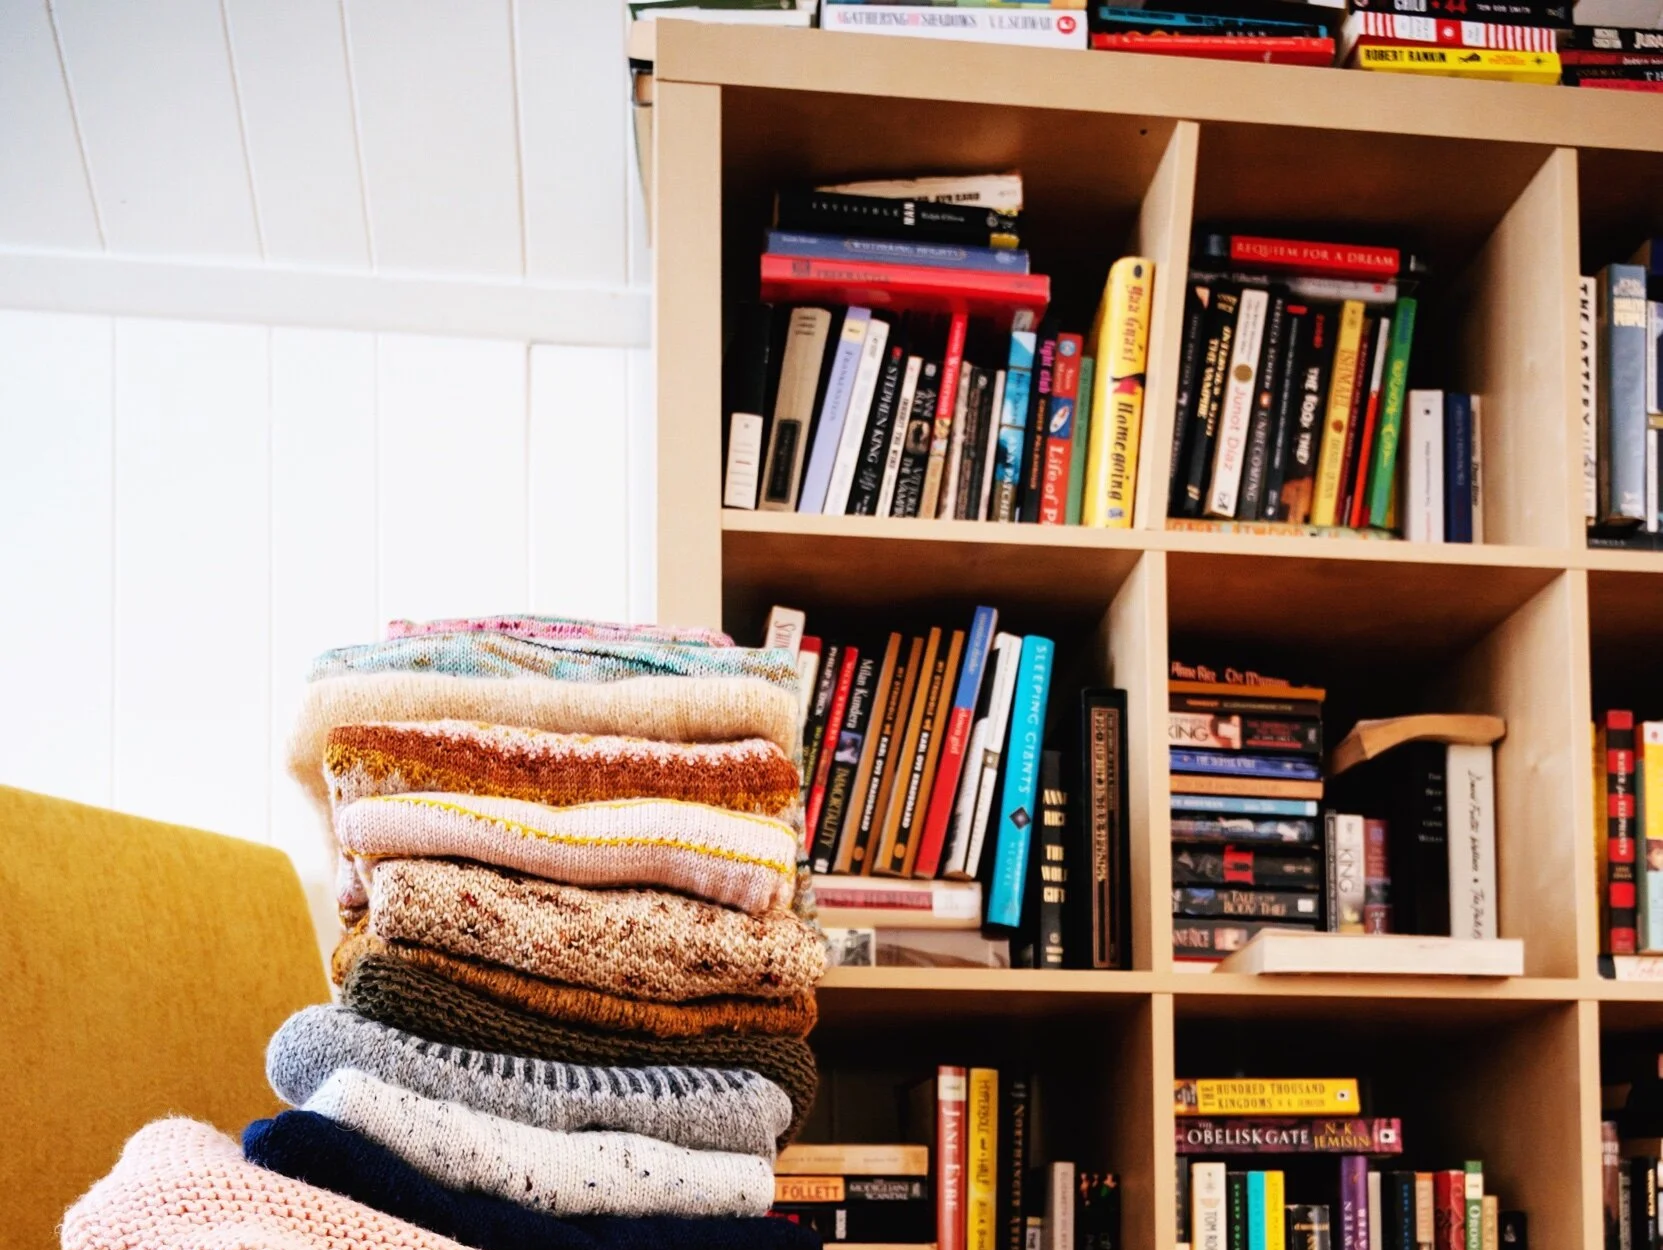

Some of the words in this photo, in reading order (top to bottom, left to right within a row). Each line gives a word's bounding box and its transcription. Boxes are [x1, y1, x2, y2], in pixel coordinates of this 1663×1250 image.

[1364, 49, 1403, 62] ROBERT
[1408, 51, 1447, 64] RANKIN
[1236, 241, 1298, 260] REQUIEM
[1303, 247, 1330, 262] FOR
[1334, 250, 1345, 262] A
[1347, 250, 1395, 267] DREAM
[1579, 284, 1590, 322] THE
[1041, 340, 1056, 367] fight
[938, 355, 960, 417] Winterson
[1038, 369, 1053, 394] club
[1196, 366, 1216, 418] VAMPIRE
[1303, 367, 1320, 390] THE
[1331, 349, 1355, 409] ISHMAEL
[876, 365, 898, 428] STEPHEN
[1229, 385, 1247, 433] Junot
[1299, 394, 1318, 429] BOOK
[866, 428, 885, 464] KING
[1108, 401, 1134, 502] Homegoing
[1245, 411, 1269, 502] UNBECOMING
[1294, 432, 1313, 466] THIEF
[1047, 444, 1065, 483] Life
[1045, 484, 1059, 509] of
[824, 648, 838, 679] PHILIP
[854, 660, 875, 686] Milan
[1026, 645, 1047, 724] SLEEPING
[815, 690, 829, 717] DICK
[846, 687, 870, 729] Kundera
[877, 736, 890, 757] KARL
[917, 731, 930, 754] KARL
[948, 736, 961, 756] girl
[1169, 724, 1210, 742] KING
[873, 759, 885, 776] OVE
[914, 755, 925, 771] OVE
[1017, 731, 1037, 795] GIANTS
[820, 767, 850, 849] IMMORTALITY
[860, 777, 881, 832] KNAUSGAARD
[901, 773, 922, 829] KNAUSGAARD
[1340, 848, 1355, 894] KING
[1202, 1085, 1215, 1108] THE
[1216, 1083, 1266, 1096] HUNDRED
[1270, 1083, 1326, 1096] THOUSAND
[1217, 1099, 1274, 1110] KINGDOMS
[942, 1108, 959, 1153] JANE
[1187, 1128, 1262, 1145] OBELISK
[1265, 1130, 1310, 1146] GATE
[1313, 1135, 1373, 1150] JEMISIN
[1011, 1103, 1025, 1207] NORTHANGER
[782, 1184, 841, 1200] FOLLETT
[944, 1162, 961, 1213] EYRE
[1232, 1182, 1241, 1220] SHARP
[1204, 1211, 1218, 1233] TOM
[1027, 1232, 1036, 1248] THE
